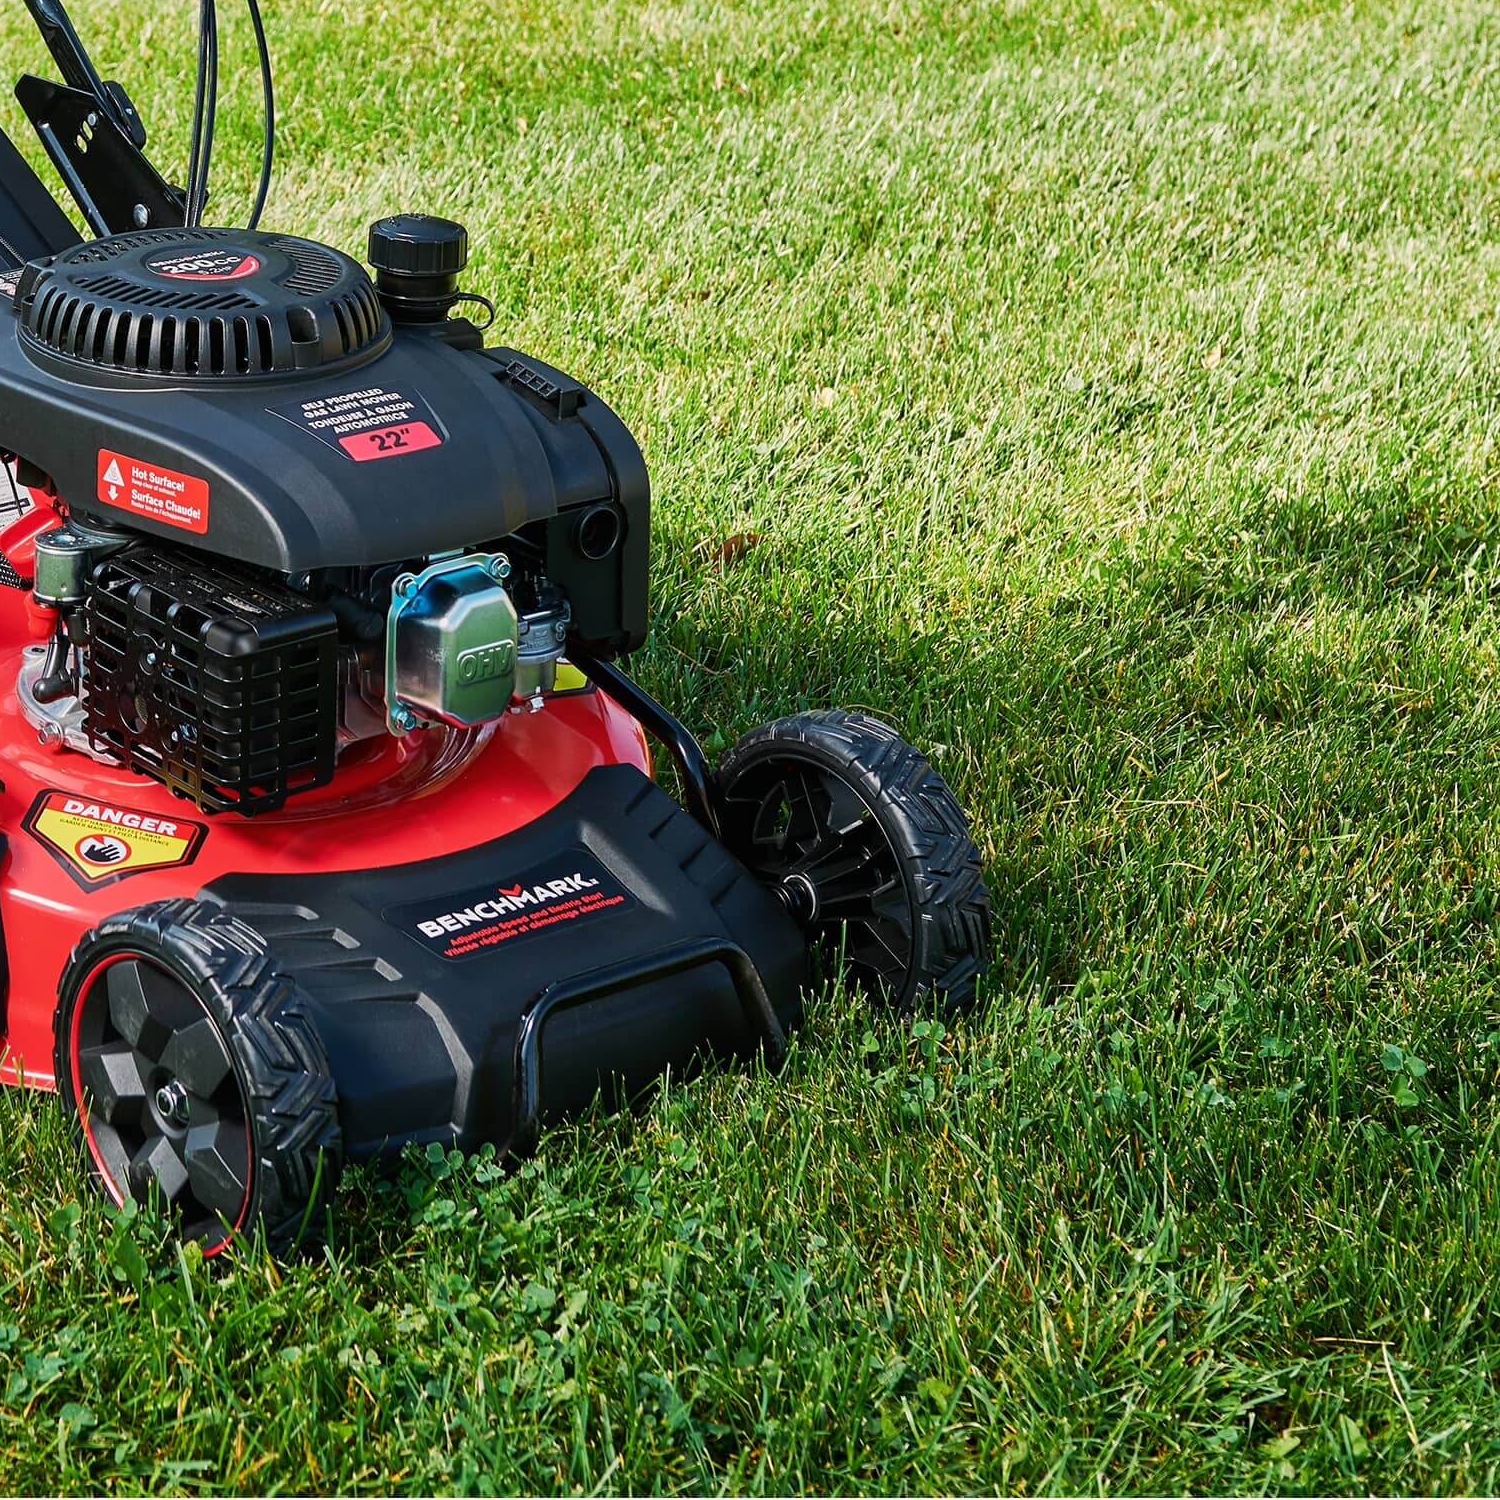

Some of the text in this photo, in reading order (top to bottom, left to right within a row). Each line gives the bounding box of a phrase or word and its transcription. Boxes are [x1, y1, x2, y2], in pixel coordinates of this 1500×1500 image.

[301, 388, 384, 411] SELF PROPELLED
[303, 392, 402, 419] GAS LAWN MOWER
[308, 411, 366, 429] TONDEUSE
[375, 401, 415, 414] GAZON
[333, 412, 409, 434] AUTOMOTRICE
[131, 466, 185, 492] Hot Surface!
[131, 489, 201, 519] Surface Chaude!
[460, 645, 511, 681] OHV
[63, 799, 178, 838] DANGER
[87, 823, 108, 832] MAINS
[89, 819, 112, 828] HANDS
[127, 828, 143, 836] FEET
[417, 873, 593, 939] BENCHMARK
[450, 891, 604, 946] Adjustable Speed and Electric Start
[444, 895, 624, 957] Vitesse réglable et démarrage électrique
